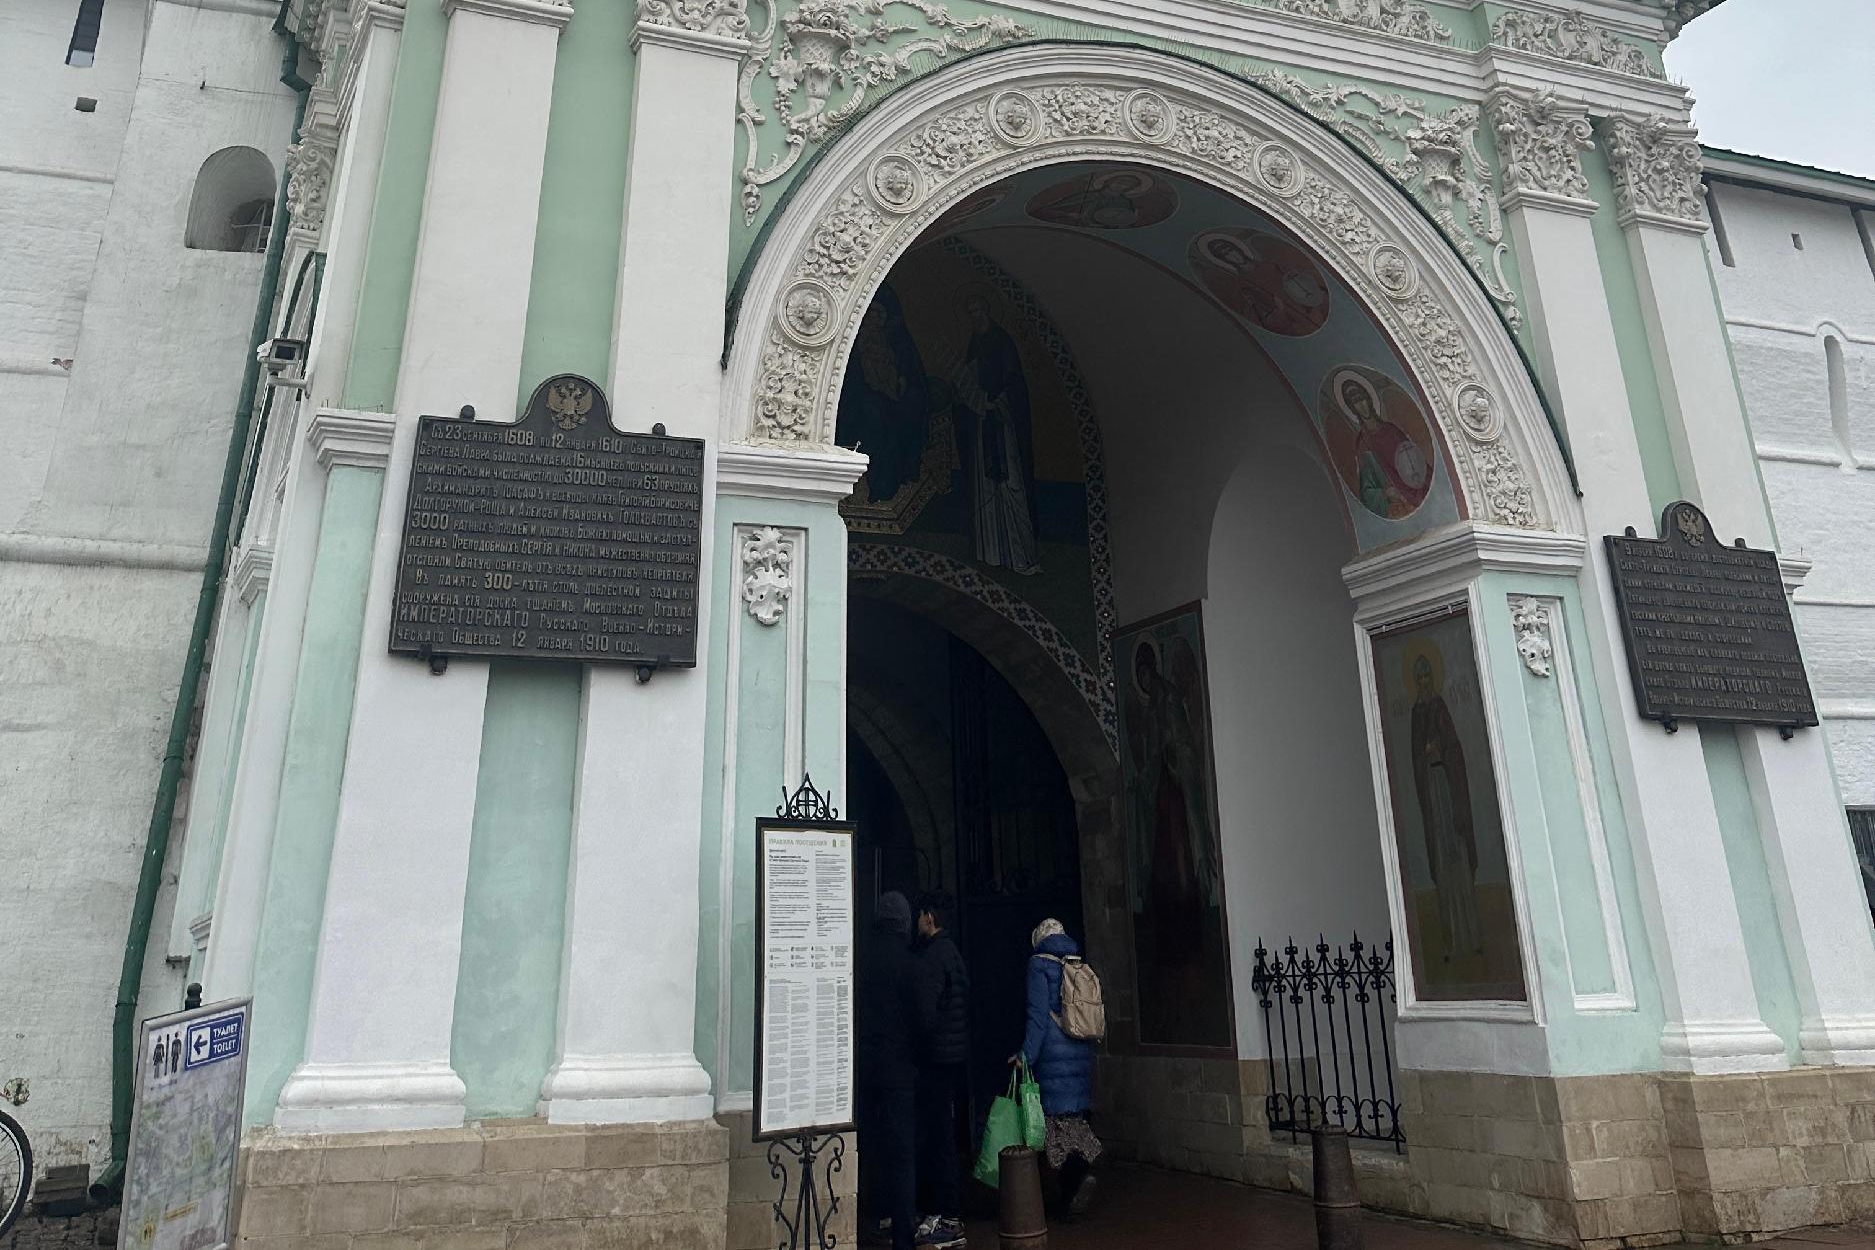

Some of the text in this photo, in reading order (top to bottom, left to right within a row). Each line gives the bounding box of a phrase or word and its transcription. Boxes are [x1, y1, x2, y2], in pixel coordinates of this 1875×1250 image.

[446, 424, 462, 440] 23
[505, 429, 534, 446] 1608
[552, 433, 564, 449] 12
[599, 437, 623, 454] 1610
[492, 450, 518, 462] БЫЛА
[573, 452, 585, 468] 16
[565, 468, 607, 486] 30000
[644, 475, 659, 490] 63
[412, 512, 450, 530] 3000
[486, 596, 518, 609] ДОСКА
[399, 603, 530, 628] ИМПЕРАТОРСКАГО
[511, 630, 528, 648] 12
[580, 633, 609, 653] 1910
[213, 1022, 238, 1038] ТУАЛЕТ
[213, 1040, 236, 1054] TOILET
